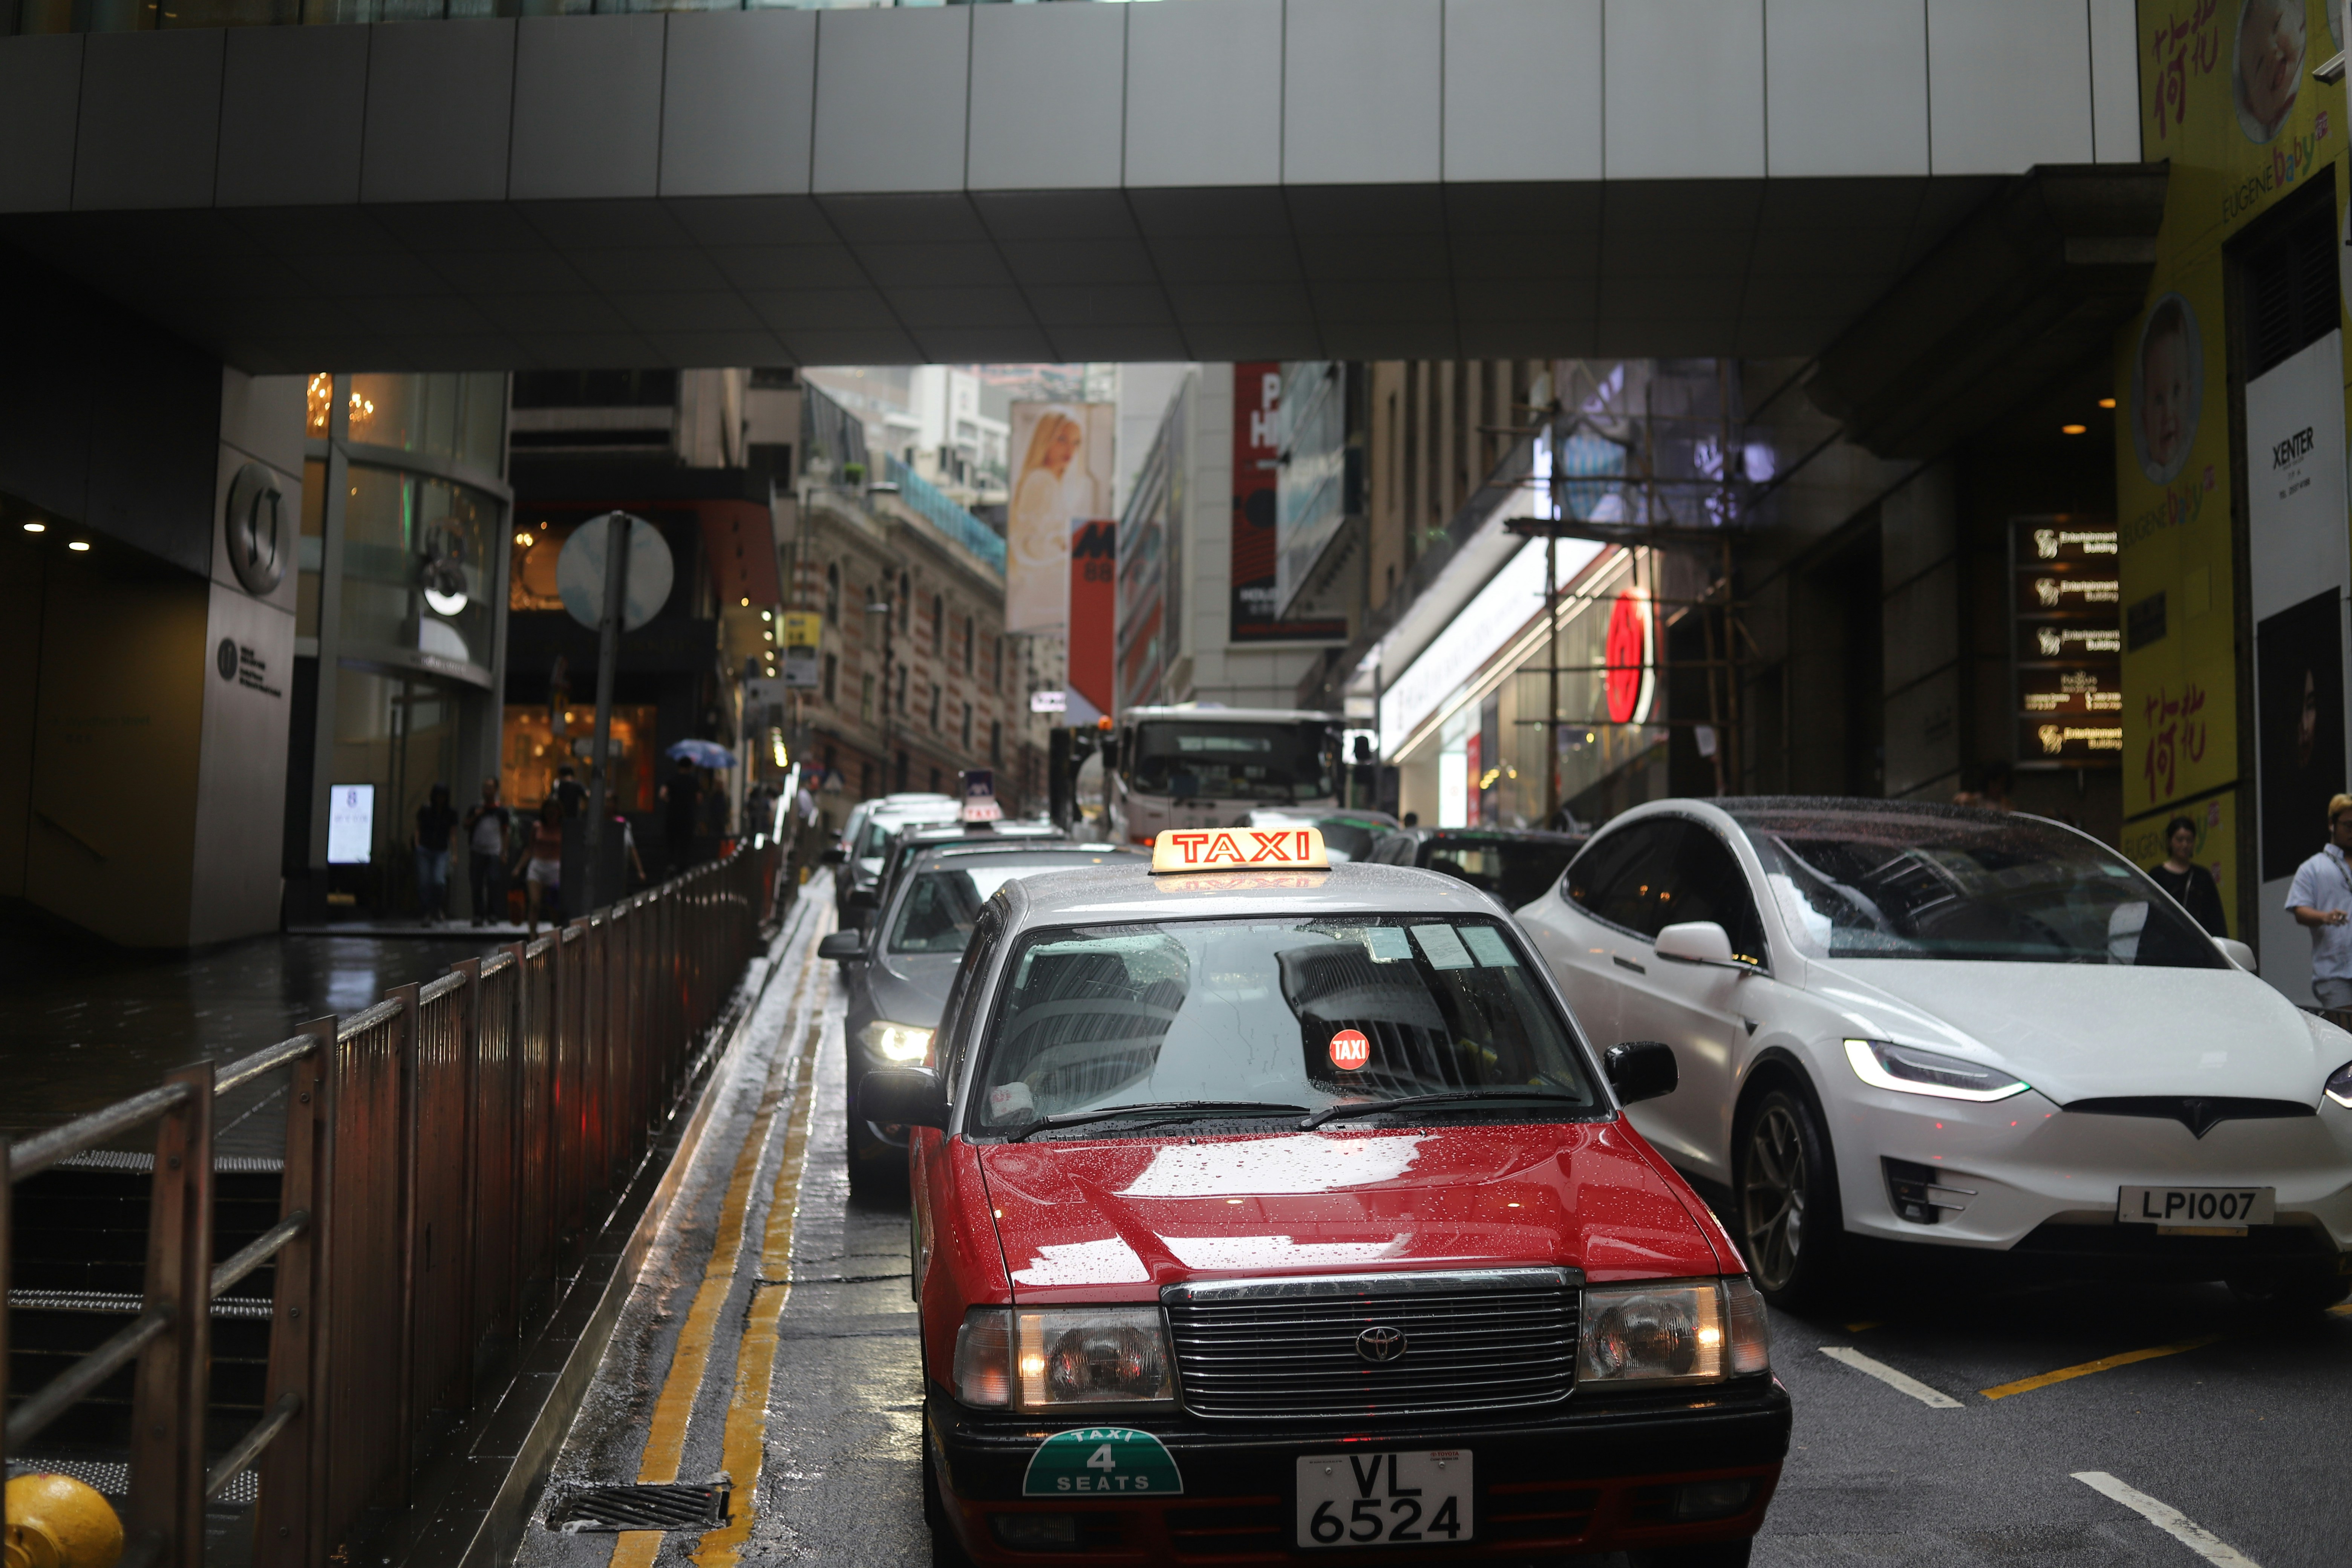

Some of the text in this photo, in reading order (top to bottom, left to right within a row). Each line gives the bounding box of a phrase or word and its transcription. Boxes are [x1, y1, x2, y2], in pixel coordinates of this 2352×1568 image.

[2272, 426, 2314, 470] XENTER
[966, 807, 998, 819] TAXI
[1173, 832, 1309, 863] TAXI
[1332, 1040, 1366, 1060] TAXI
[1070, 1429, 1134, 1442] TAXI
[1087, 1444, 1116, 1473] 4
[1057, 1476, 1149, 1491] SEATS
[1349, 1454, 1422, 1498] VL
[1310, 1496, 1461, 1544] 6524
